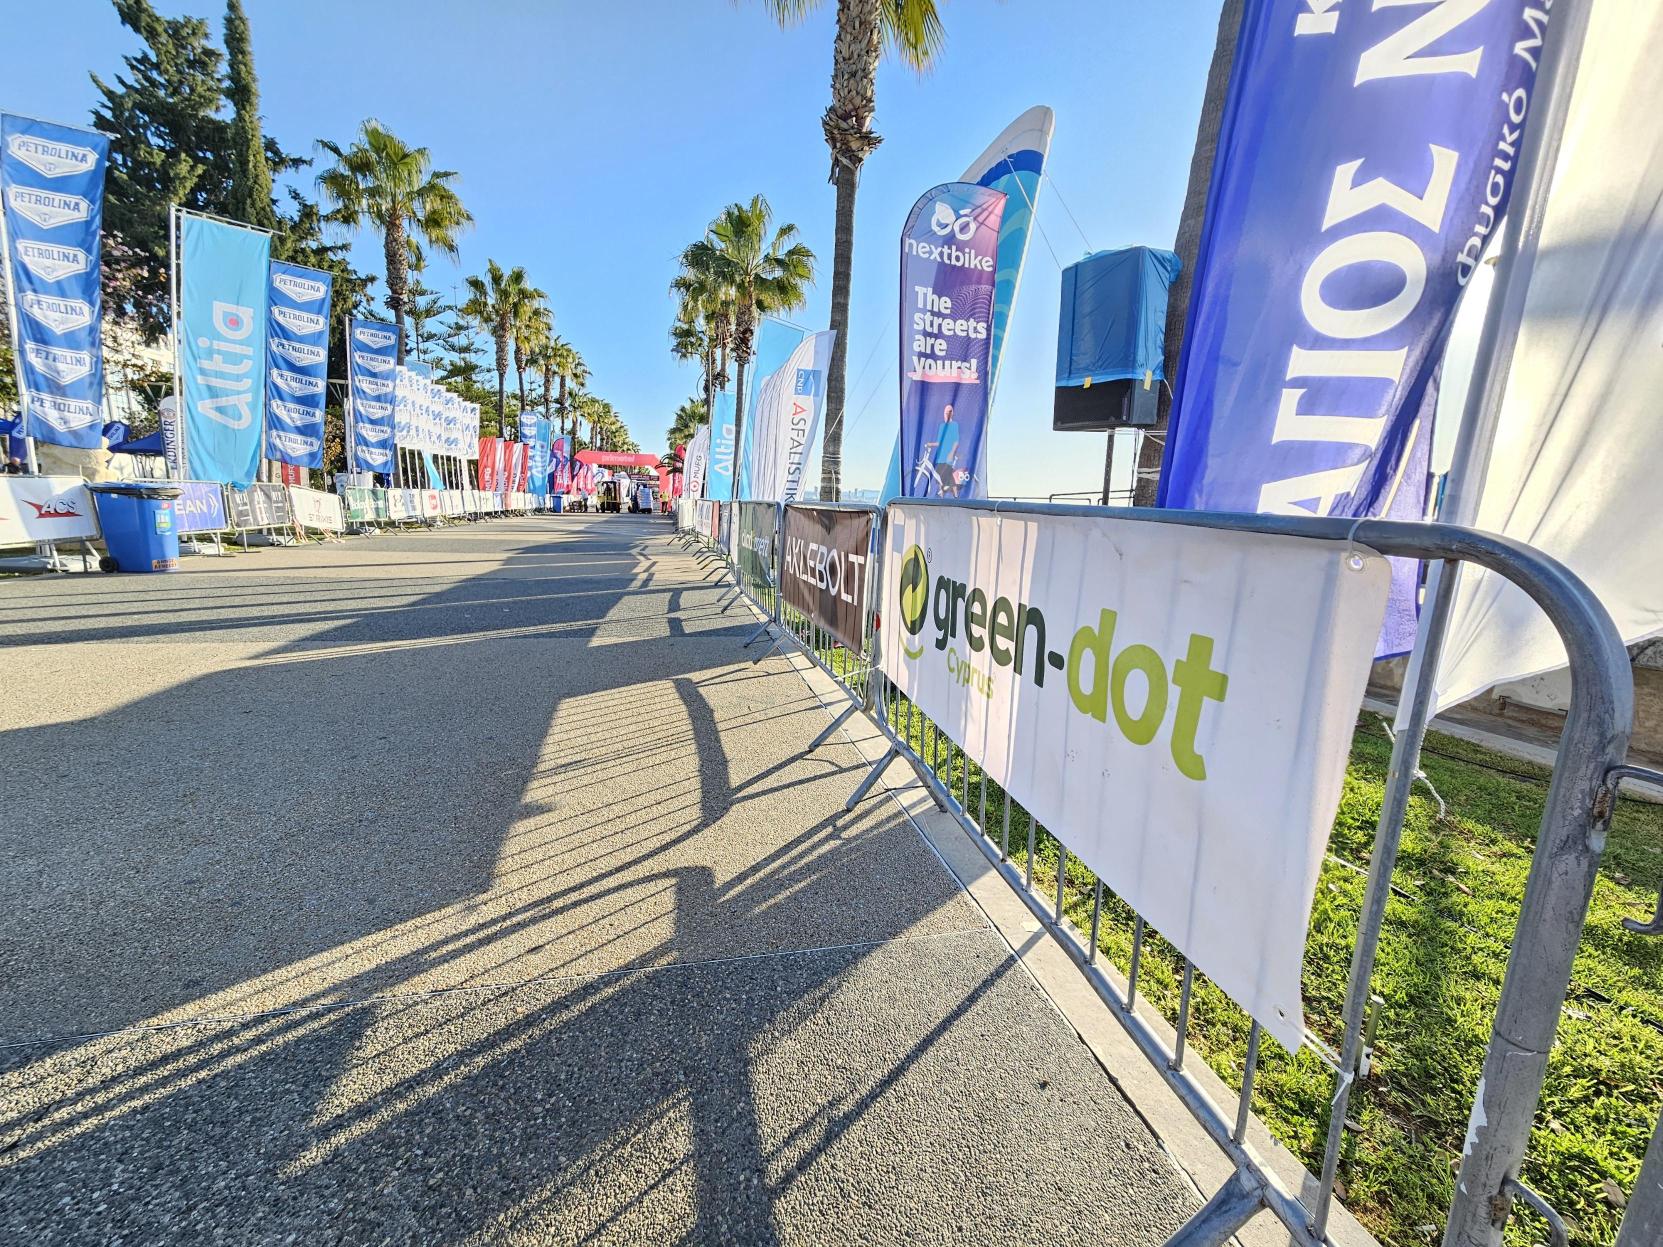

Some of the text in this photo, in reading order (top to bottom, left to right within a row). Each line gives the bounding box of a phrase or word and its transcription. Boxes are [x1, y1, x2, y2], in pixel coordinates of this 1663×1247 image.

[18, 140, 89, 165] PETROLINA
[14, 191, 81, 214] PETROLINA
[24, 246, 80, 265] ETROLINA
[905, 238, 994, 272] nextbike
[279, 278, 321, 294] PETROLINA
[914, 285, 952, 314] The
[278, 310, 320, 326] PETROLINA
[914, 311, 988, 339] streets
[277, 341, 321, 358] PETROLINA
[913, 333, 947, 356] are
[912, 355, 979, 381] yours!
[694, 455, 702, 479] MUFG
[41, 500, 77, 514] ACS
[934, 575, 1229, 781] green-dot
[947, 647, 995, 699] Cyprus
